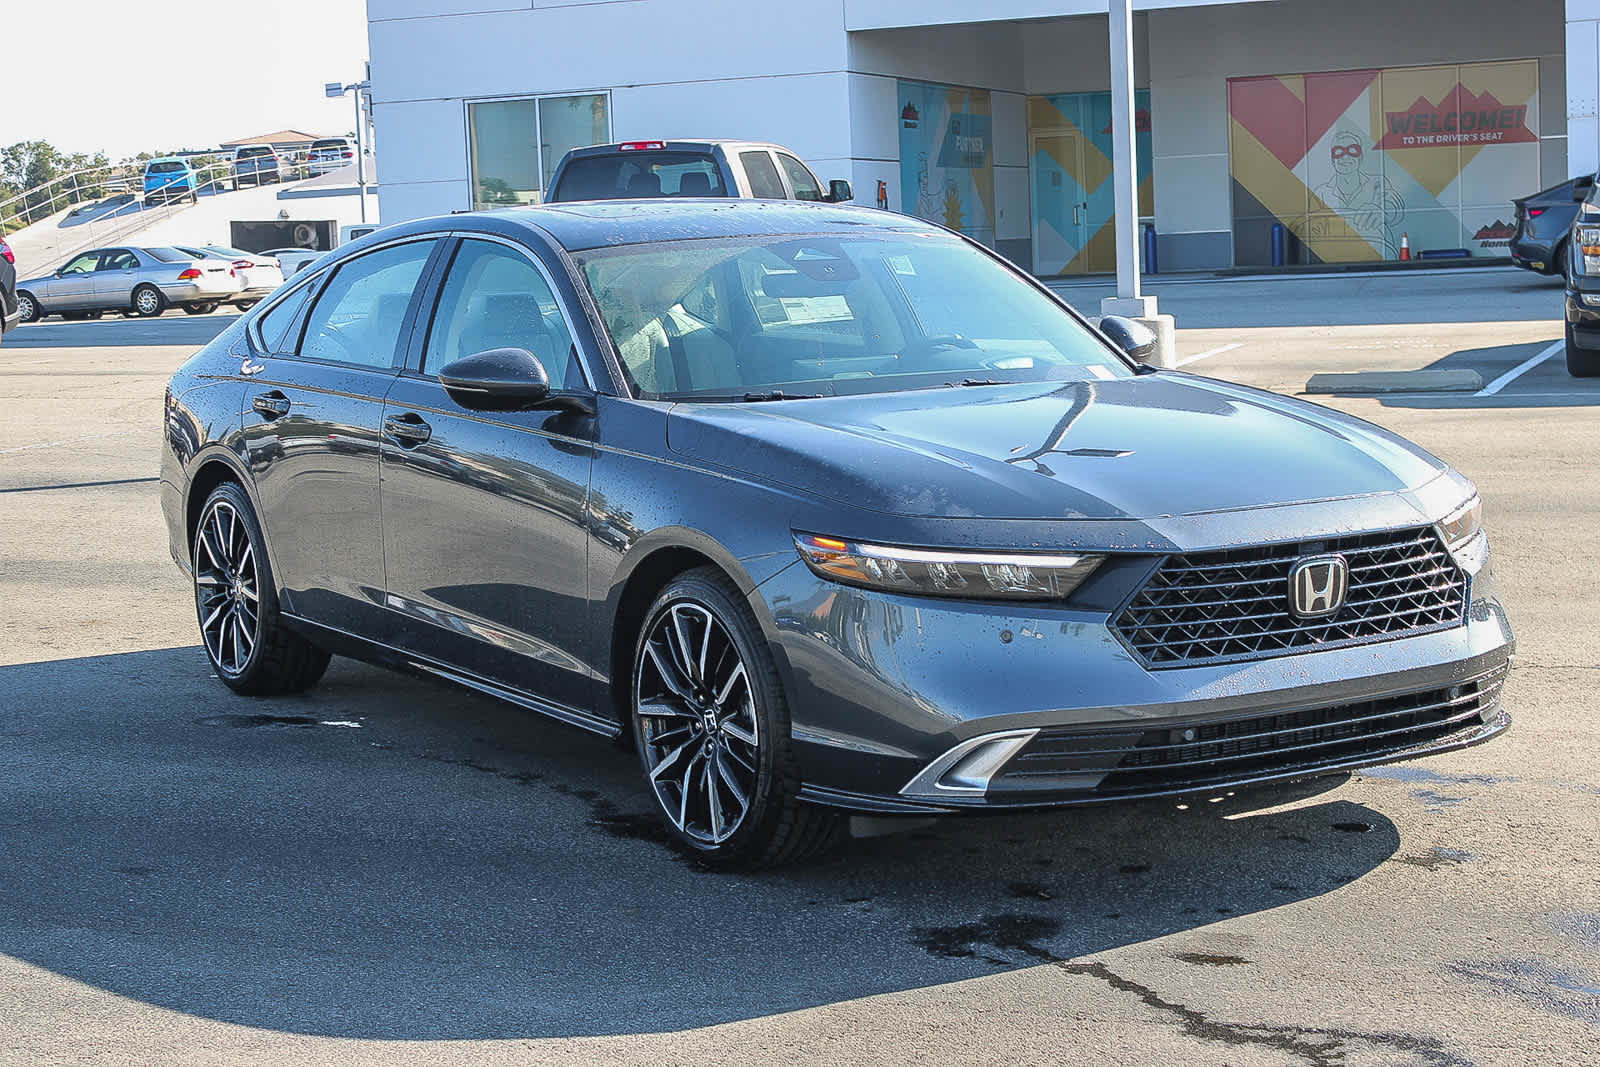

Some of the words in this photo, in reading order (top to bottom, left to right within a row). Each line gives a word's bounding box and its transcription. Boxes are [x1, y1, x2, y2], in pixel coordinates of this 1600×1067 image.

[1390, 108, 1523, 134] WELCOME!
[1403, 136, 1415, 144] TO
[1416, 134, 1434, 143] THE
[1436, 132, 1478, 143] DRIVER'S
[1480, 132, 1504, 141] SEAT
